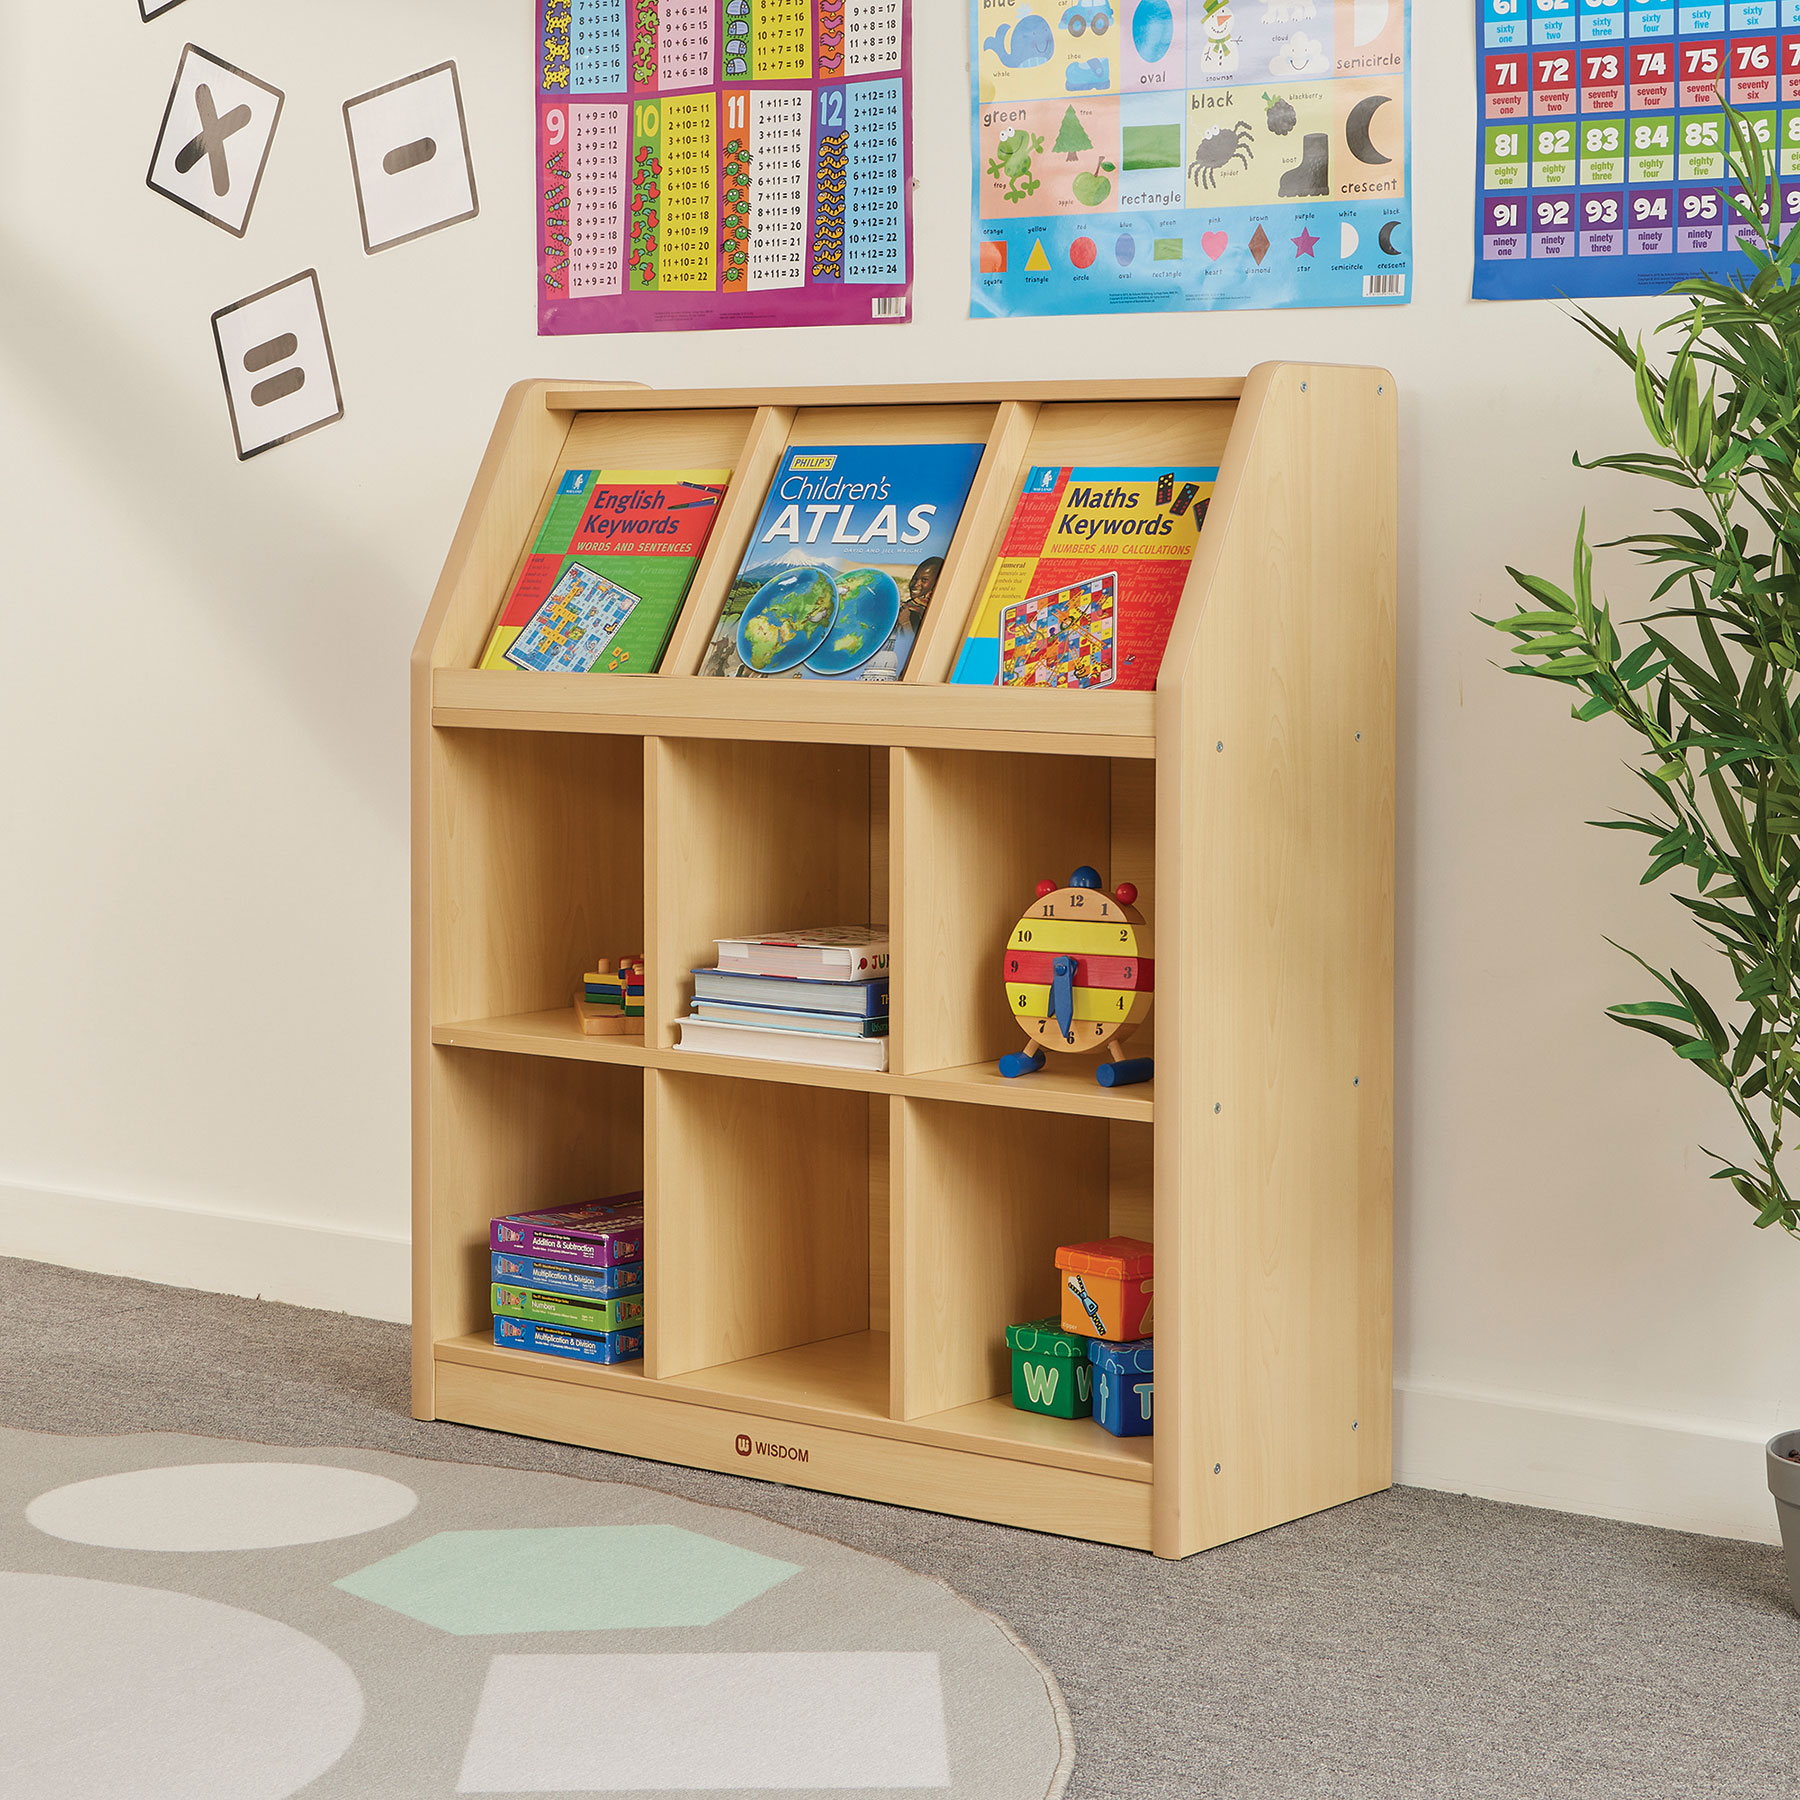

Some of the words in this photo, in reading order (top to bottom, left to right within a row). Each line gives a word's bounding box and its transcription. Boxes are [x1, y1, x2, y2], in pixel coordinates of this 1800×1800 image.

[1493, 0, 1517, 14] 61
[1743, 6, 1762, 16] sixty
[1692, 10, 1711, 20] sixty
[1747, 17, 1759, 25] six
[1497, 24, 1514, 34] sixty
[1593, 18, 1611, 27] sixty
[1592, 28, 1612, 36] three
[1337, 55, 1401, 69] semicircle
[1637, 52, 1666, 76] 74
[1686, 48, 1718, 73] 75
[1737, 45, 1769, 70] 76
[663, 70, 672, 78] 12
[683, 69, 687, 77] 6
[699, 67, 708, 76] 18
[1539, 58, 1569, 82] 72
[1587, 55, 1618, 79] 73
[1140, 71, 1166, 84] oval
[1495, 62, 1517, 86] 71
[1637, 86, 1667, 96] seventy
[1738, 80, 1769, 90] seventy
[1192, 91, 1233, 110] black
[1492, 96, 1521, 105] seventy
[1540, 92, 1569, 102] seventy
[1588, 89, 1618, 99] seventy
[1747, 91, 1759, 99] six
[1593, 100, 1613, 109] three
[1644, 97, 1660, 106] four
[728, 96, 744, 129] 11
[820, 91, 842, 126] 12
[636, 105, 659, 137] 10
[984, 109, 1026, 127] green
[547, 109, 565, 145] 9
[1587, 127, 1618, 152] 83
[1635, 125, 1669, 149] 84
[1685, 122, 1718, 146] 85
[1495, 134, 1518, 156] 81
[1538, 129, 1570, 154] 82
[1590, 162, 1614, 172] eighty
[1689, 156, 1714, 166] eighty
[1494, 167, 1518, 176] eighty
[1592, 172, 1612, 180] three
[1694, 167, 1709, 176] five
[1341, 178, 1397, 194] crescent
[1121, 191, 1181, 205] rectangle
[1538, 201, 1569, 225] 92
[1586, 199, 1617, 223] 93
[1634, 197, 1667, 221] 94
[1684, 195, 1717, 219] 95
[1294, 213, 1315, 221] purple
[1494, 204, 1517, 227] 91
[1589, 233, 1613, 243] ninety
[1638, 231, 1662, 242] ninety
[1688, 229, 1712, 240] ninety
[1493, 237, 1517, 247] ninety
[1591, 244, 1611, 252] three
[1642, 242, 1658, 250] four
[1692, 240, 1707, 249] five
[573, 278, 582, 286] 12
[592, 277, 596, 285] 9
[794, 458, 832, 468] PHILIP'S
[780, 476, 891, 500] Children's
[594, 490, 665, 513] English
[1066, 487, 1140, 508] Maths
[584, 514, 680, 538] Keywords
[761, 504, 937, 544] ATLAS
[1058, 514, 1173, 540] Keywords
[576, 542, 611, 551] WORDS
[614, 543, 634, 551] AND
[637, 543, 692, 552] SENTENCES
[1050, 544, 1096, 554] NUMBERS
[1100, 544, 1118, 554] AND
[1122, 544, 1191, 554] CALCULATIONS
[1069, 894, 1084, 907] 12
[1042, 904, 1055, 916] 11
[1100, 904, 1108, 916] 1
[1018, 930, 1032, 943] 10
[1120, 930, 1128, 942] 2
[1011, 960, 1018, 973] 9
[1124, 967, 1132, 979] 3
[1018, 995, 1026, 1007] 8
[1116, 996, 1124, 1010] 4
[1039, 1020, 1047, 1033] 7
[1095, 1023, 1103, 1035] 5
[1066, 1031, 1074, 1044] 6
[533, 1238, 555, 1247] Addition
[563, 1242, 594, 1252] Subtraction
[533, 1268, 567, 1280] Multiplication
[574, 1276, 594, 1284] Division
[532, 1301, 555, 1311] Numbers
[535, 1332, 569, 1344] Multiplication
[576, 1340, 596, 1349] Division
[1023, 1361, 1059, 1406] W
[755, 1441, 809, 1463] WISDOM
